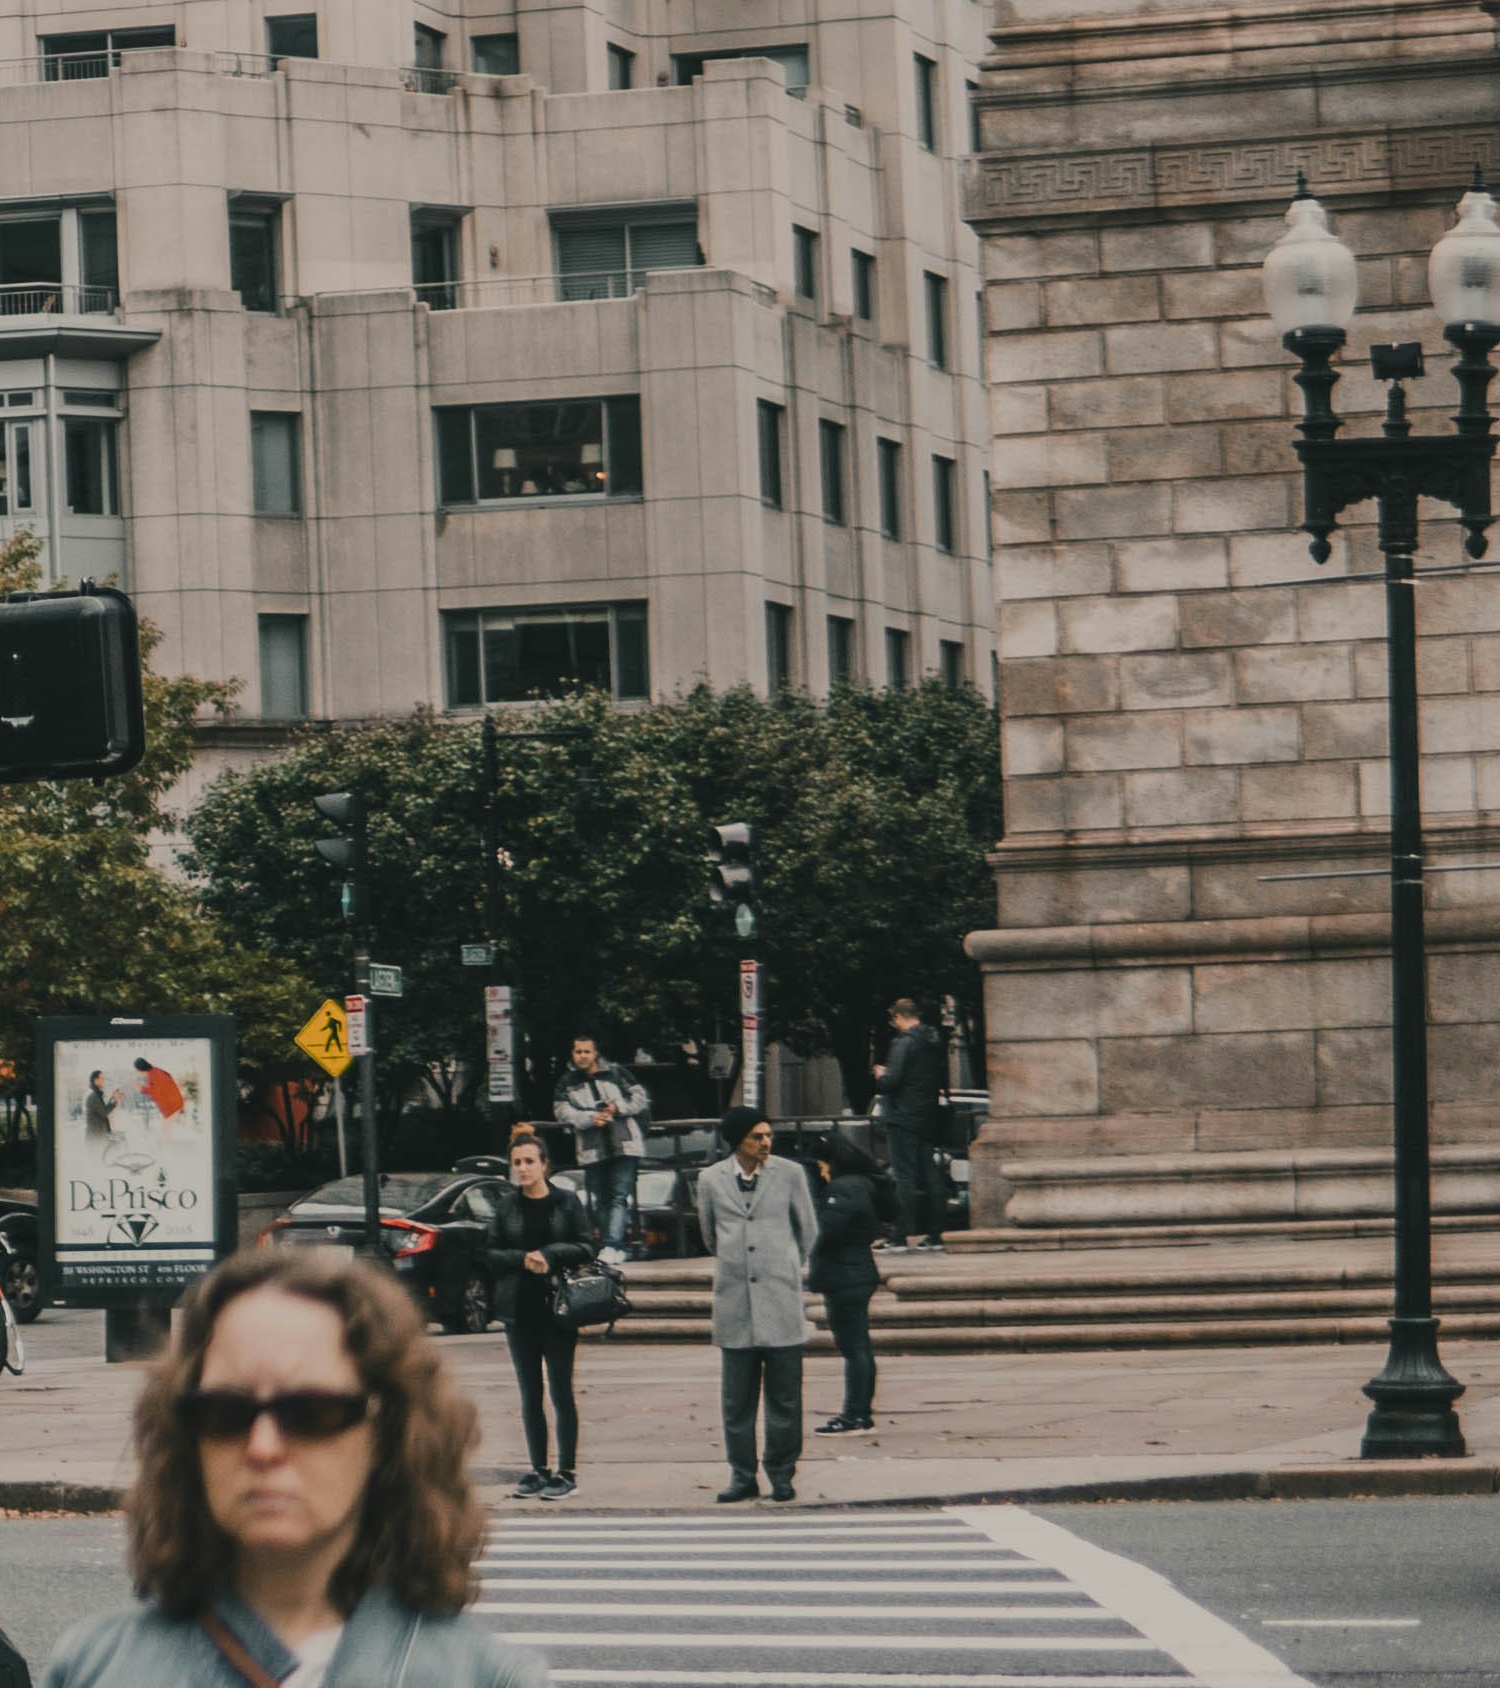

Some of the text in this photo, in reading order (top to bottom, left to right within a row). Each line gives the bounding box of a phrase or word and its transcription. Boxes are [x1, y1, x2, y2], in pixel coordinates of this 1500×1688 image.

[70, 1178, 197, 1211] DePrisco
[75, 1265, 135, 1275] WASHINGTON
[137, 1265, 149, 1274] ST
[174, 1264, 207, 1273] FLOOR
